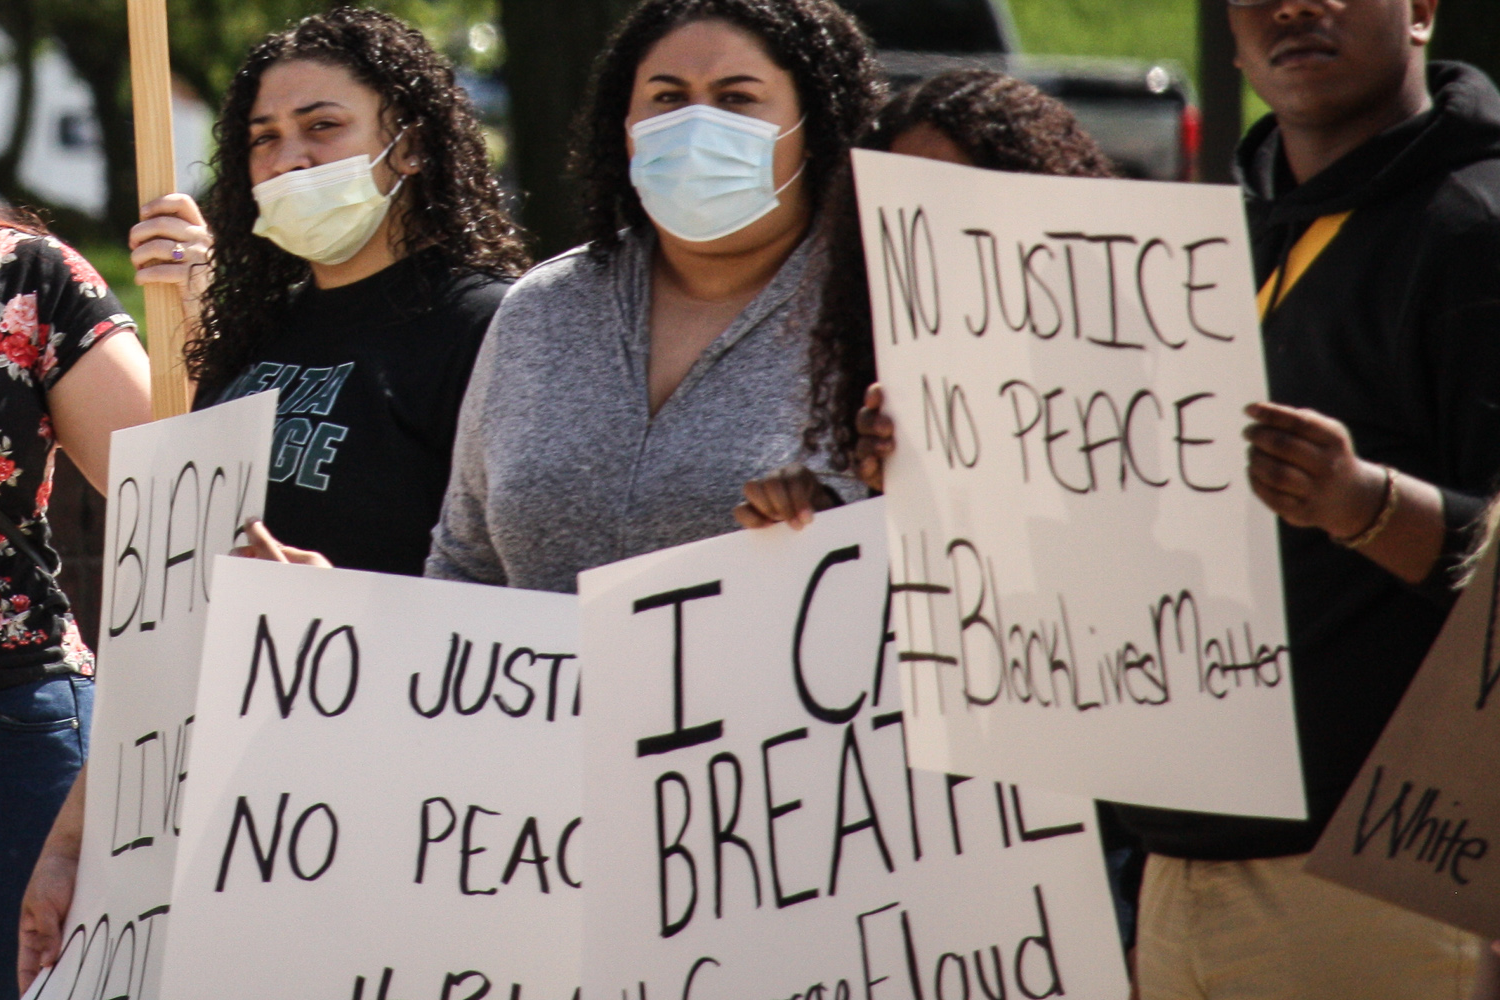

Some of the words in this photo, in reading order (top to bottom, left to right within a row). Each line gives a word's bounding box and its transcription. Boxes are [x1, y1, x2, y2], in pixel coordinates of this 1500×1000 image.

[878, 204, 942, 345] NO
[961, 229, 1235, 350] JUSTICE
[269, 417, 349, 491] GE
[921, 374, 979, 469] NO
[999, 379, 1231, 494] PEACE
[109, 459, 252, 640] BLACK
[239, 614, 360, 719] NO
[632, 579, 724, 758] I
[890, 530, 1289, 716] #BlackLivesMatter
[214, 792, 339, 892] NO
[1352, 765, 1488, 885] White
